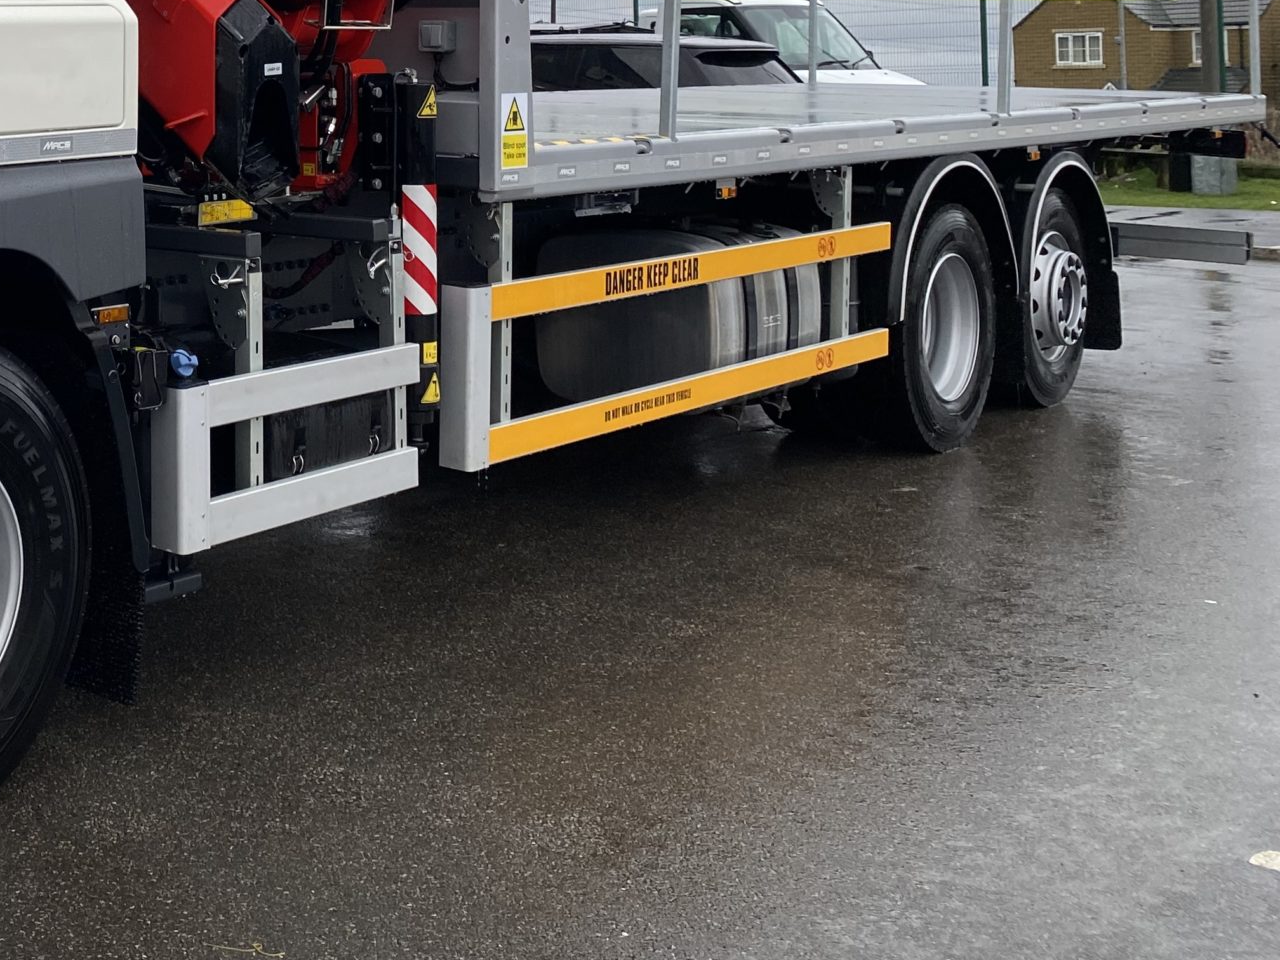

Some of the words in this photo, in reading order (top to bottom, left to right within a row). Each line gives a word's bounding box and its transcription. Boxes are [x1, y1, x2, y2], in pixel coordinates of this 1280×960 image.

[42, 140, 71, 151] MACS
[605, 266, 644, 296] DANGER
[646, 262, 669, 288] KEEP
[671, 257, 699, 283] CLEAR
[0, 419, 63, 552] FUELMAX
